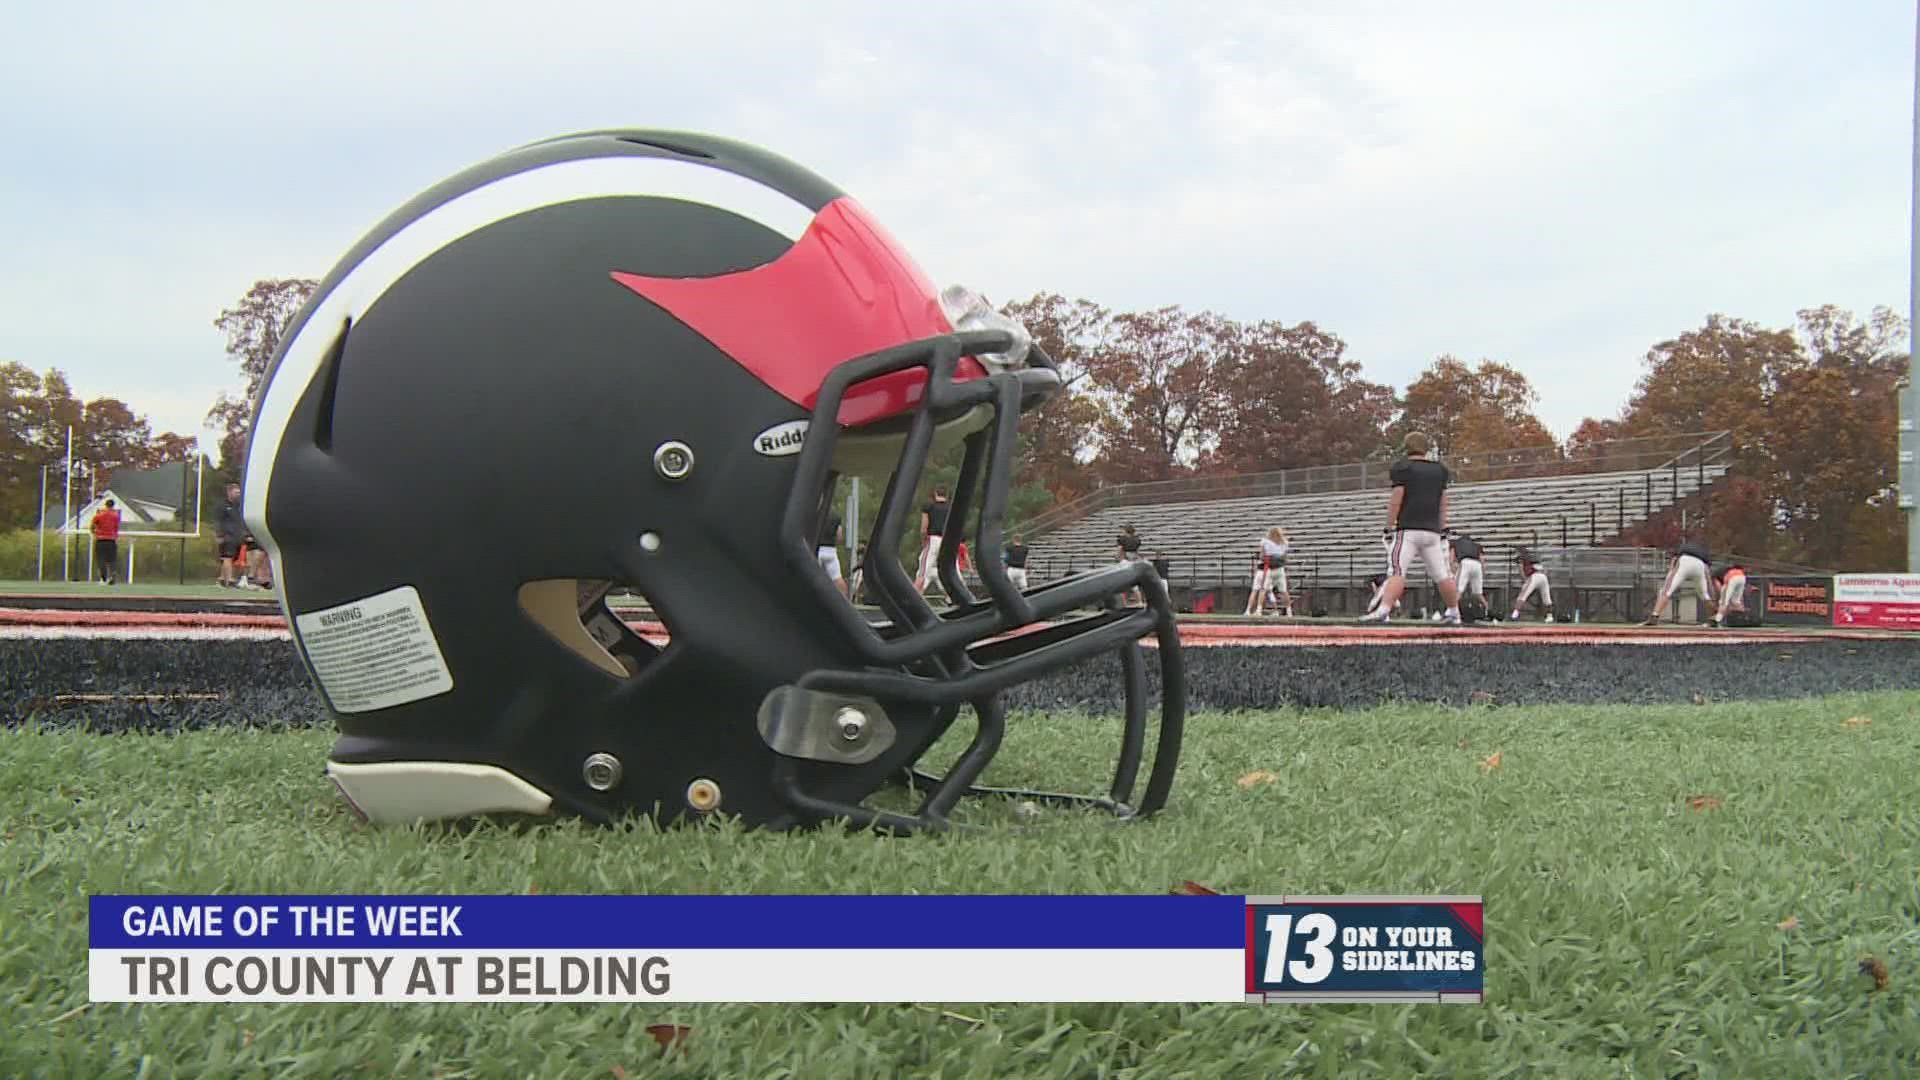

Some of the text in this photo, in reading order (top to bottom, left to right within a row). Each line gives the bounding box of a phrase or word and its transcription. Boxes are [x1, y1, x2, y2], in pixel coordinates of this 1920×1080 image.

[1768, 582, 1825, 598] Imagine
[1767, 598, 1828, 616] Learning
[318, 607, 362, 627] WARNING
